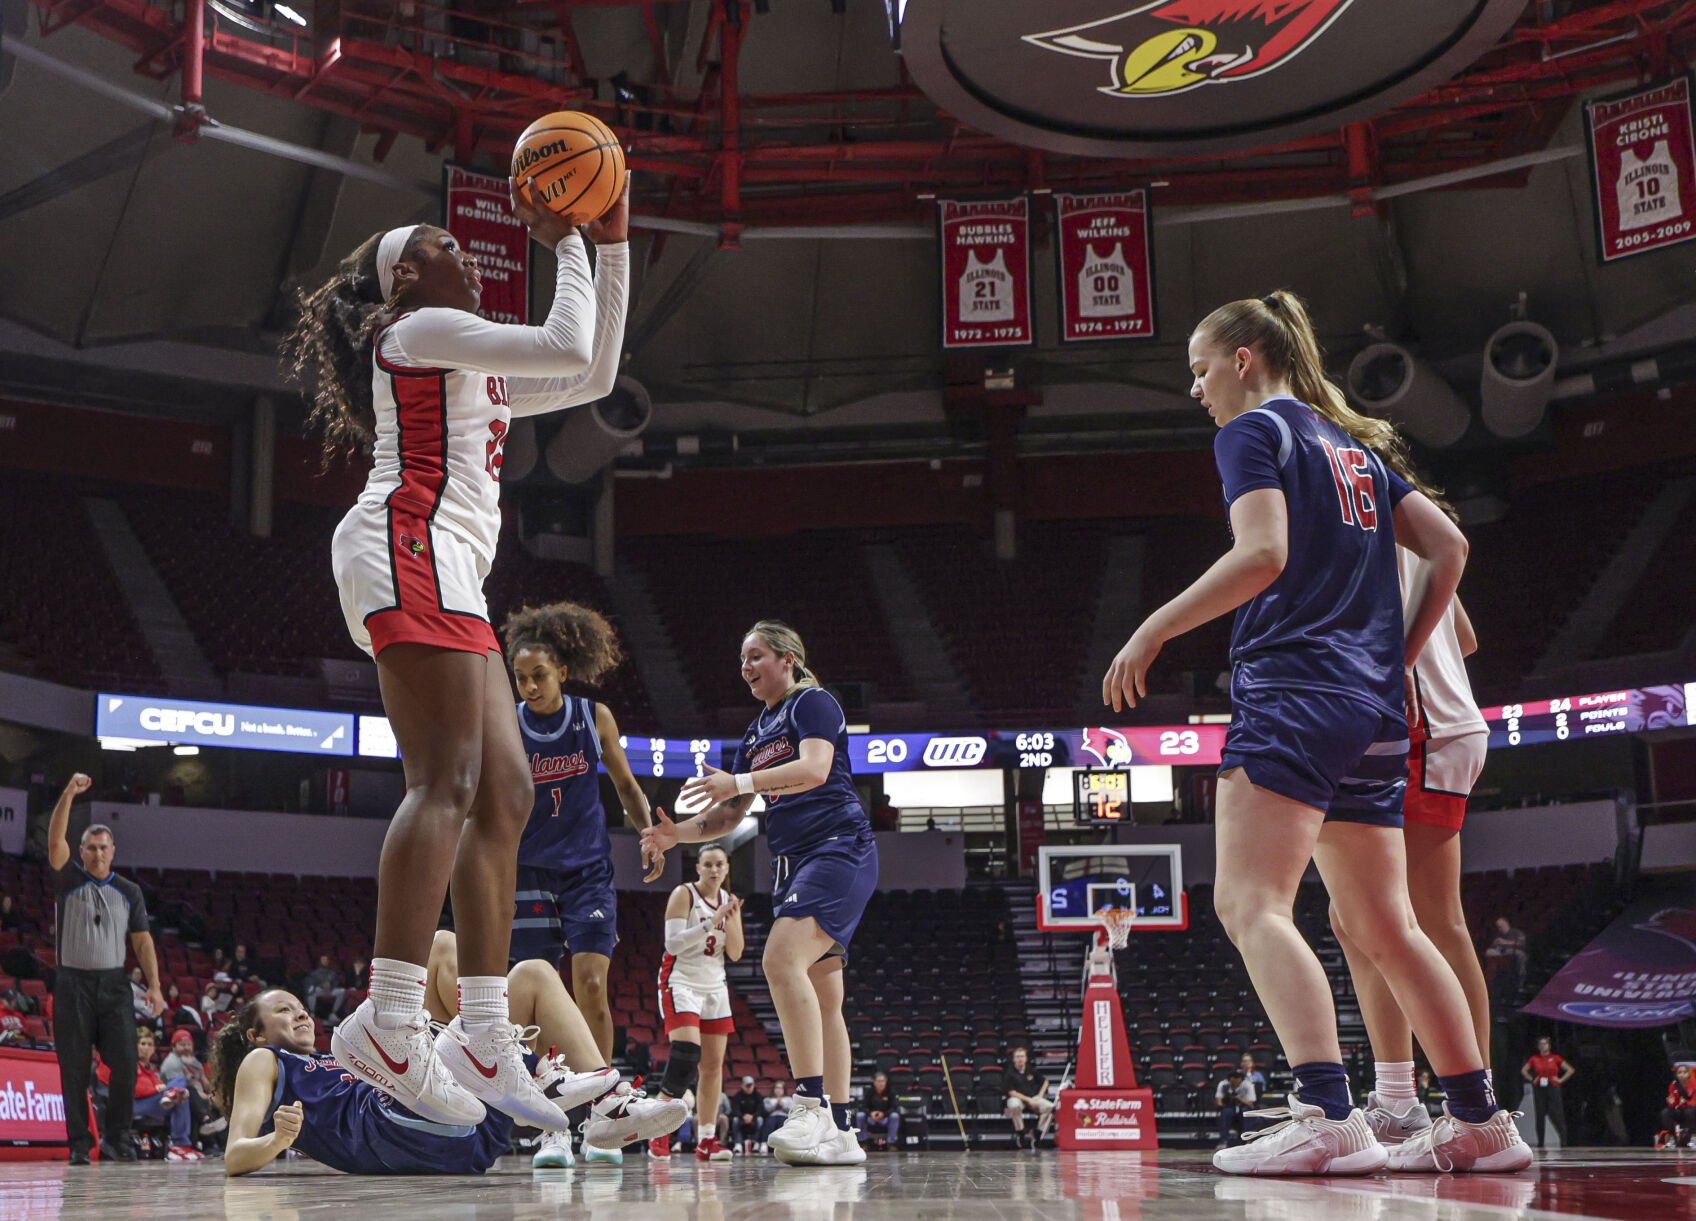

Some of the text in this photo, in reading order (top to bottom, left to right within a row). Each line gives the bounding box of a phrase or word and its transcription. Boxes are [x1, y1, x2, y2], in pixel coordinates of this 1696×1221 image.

[1619, 113, 1664, 134] KRISTI
[1616, 123, 1670, 147] CIRONE
[1624, 163, 1670, 186] ILLINOIS
[1635, 177, 1661, 198] 10
[475, 199, 503, 213] WILL
[1633, 196, 1666, 216] STATE
[456, 205, 521, 228] ROBINSON
[1090, 217, 1117, 228] JEFF
[959, 223, 1013, 236] BUBBLES
[1077, 226, 1130, 239] WILKINS
[1615, 220, 1692, 250] 2005-2009
[469, 239, 507, 255] MEN'S
[956, 234, 1016, 246] HAWKINS
[473, 255, 523, 272] KETBALL
[1085, 262, 1126, 277] ILLINOIS
[479, 268, 509, 282] OACH
[966, 269, 1006, 283] ILLINOIS
[1093, 275, 1119, 292] 00
[975, 281, 996, 298] 21
[972, 300, 1001, 311] STATE
[1092, 295, 1122, 306] STATE
[1318, 434, 1378, 533] 16
[1502, 692, 1627, 719] 23 24 PLAYER
[140, 707, 235, 736] CEFCU
[1508, 706, 1628, 732] 2 2 POINTS
[1015, 733, 1055, 751] 6:03
[1509, 721, 1626, 745] 0 0 FOULS
[690, 739, 711, 753] 20
[867, 738, 983, 764] 20 UIC
[1159, 730, 1199, 756] 23
[527, 750, 588, 779] lames
[653, 751, 664, 764] 0
[1019, 752, 1053, 768] 2ND
[653, 763, 704, 777] 0 1
[551, 787, 562, 817] 1
[1096, 792, 1122, 819] 12
[703, 935, 718, 957] 3
[1589, 1002, 1690, 1019] Ford
[1096, 1001, 1112, 1085] HELLER
